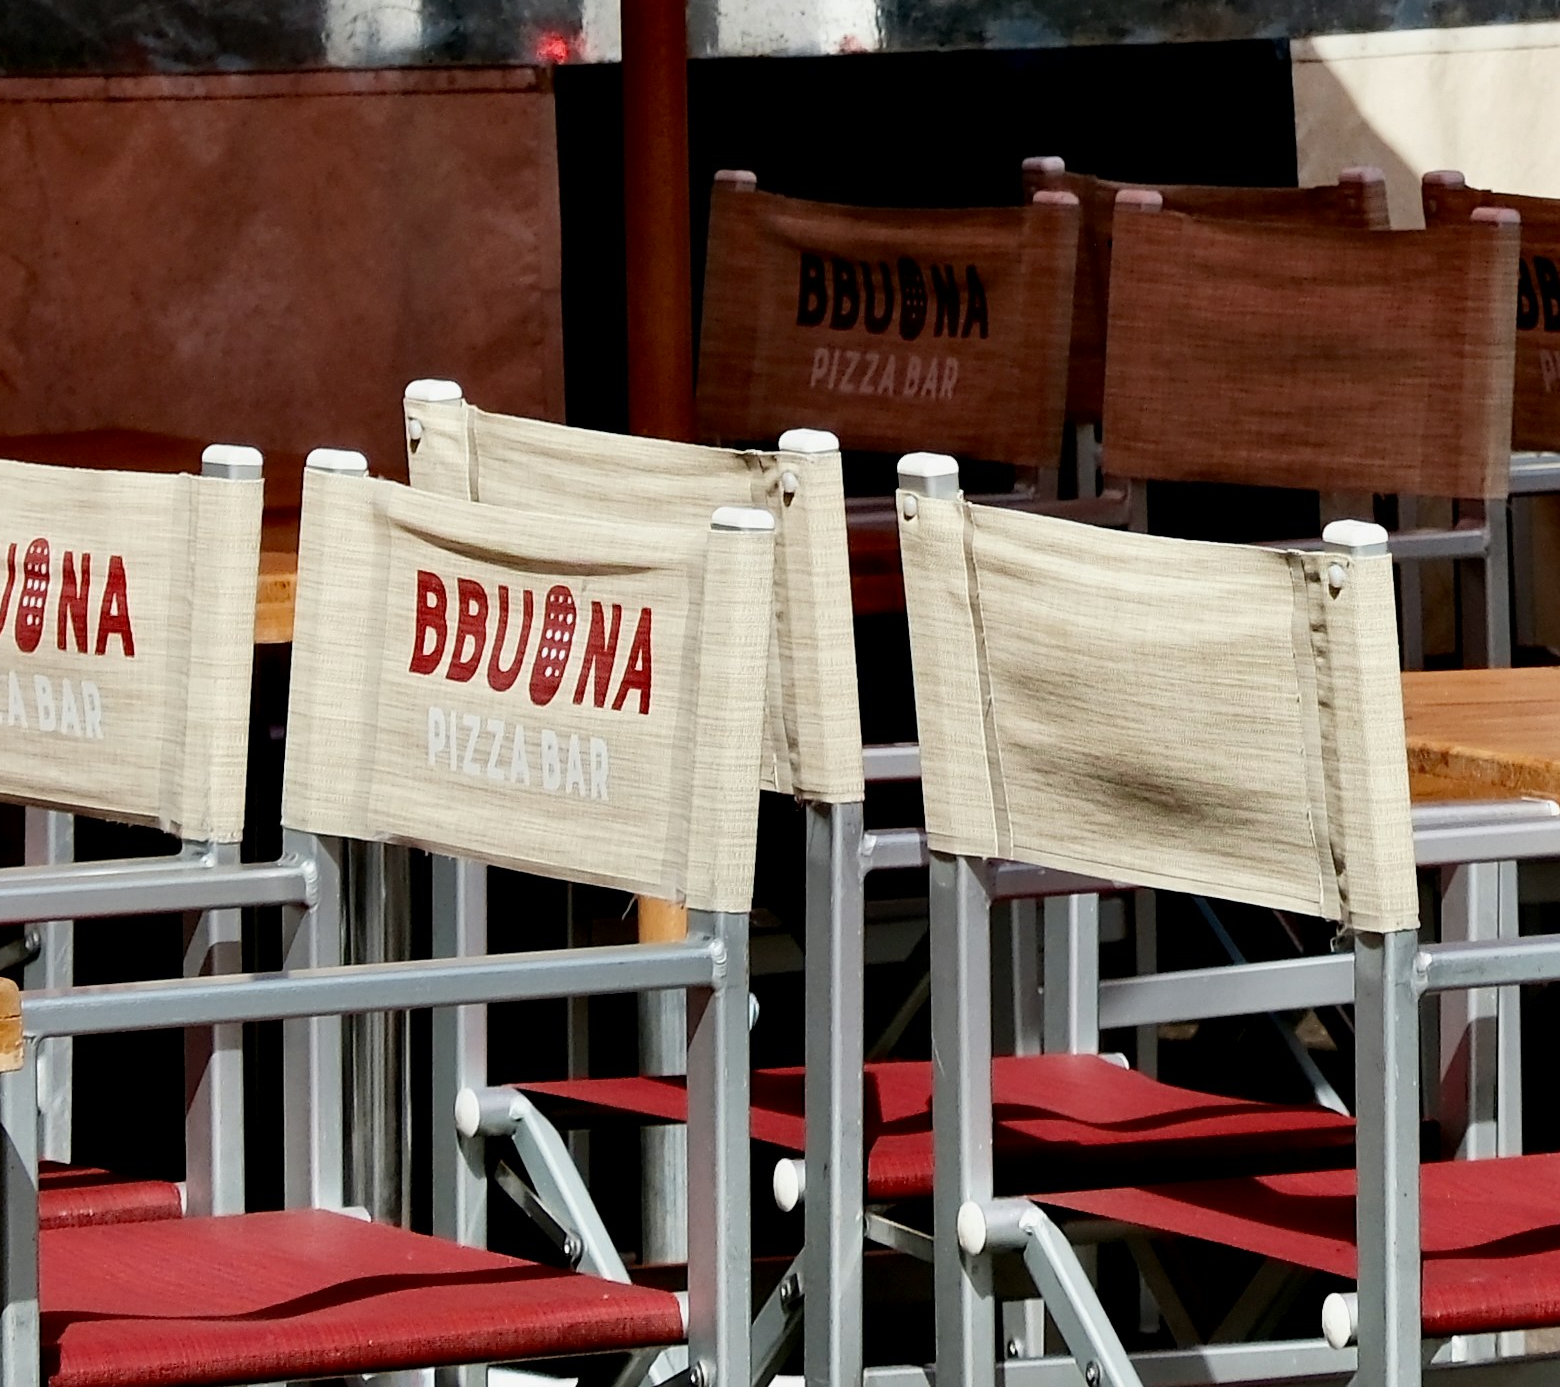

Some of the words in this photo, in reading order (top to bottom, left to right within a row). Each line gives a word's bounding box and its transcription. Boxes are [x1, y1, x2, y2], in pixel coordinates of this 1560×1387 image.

[810, 347, 896, 396] PIZZA
[902, 355, 959, 400] BAR
[34, 674, 104, 740] BAR
[427, 706, 531, 787] PIZZA
[541, 729, 610, 802] BAR
